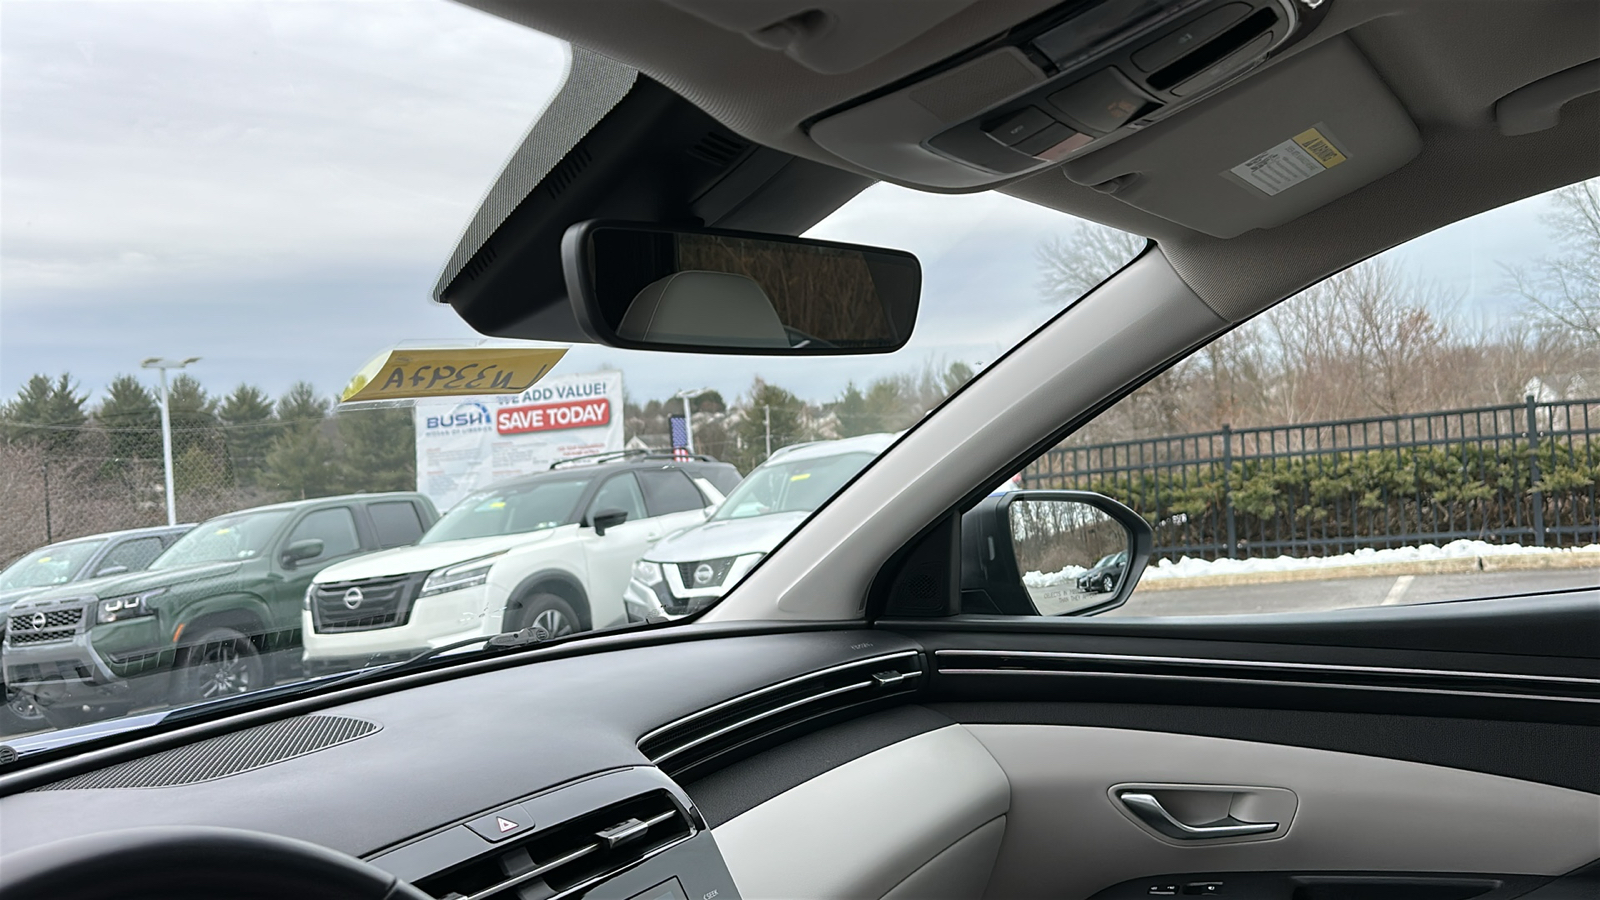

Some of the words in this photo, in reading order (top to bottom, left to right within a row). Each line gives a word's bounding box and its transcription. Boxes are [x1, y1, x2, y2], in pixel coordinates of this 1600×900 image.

[522, 388, 553, 402] ADD
[556, 382, 607, 399] VALUE!
[427, 412, 483, 429] BUSH
[498, 409, 544, 431] SAVE
[546, 402, 607, 426] TODAY
[707, 889, 718, 899] SEEK
